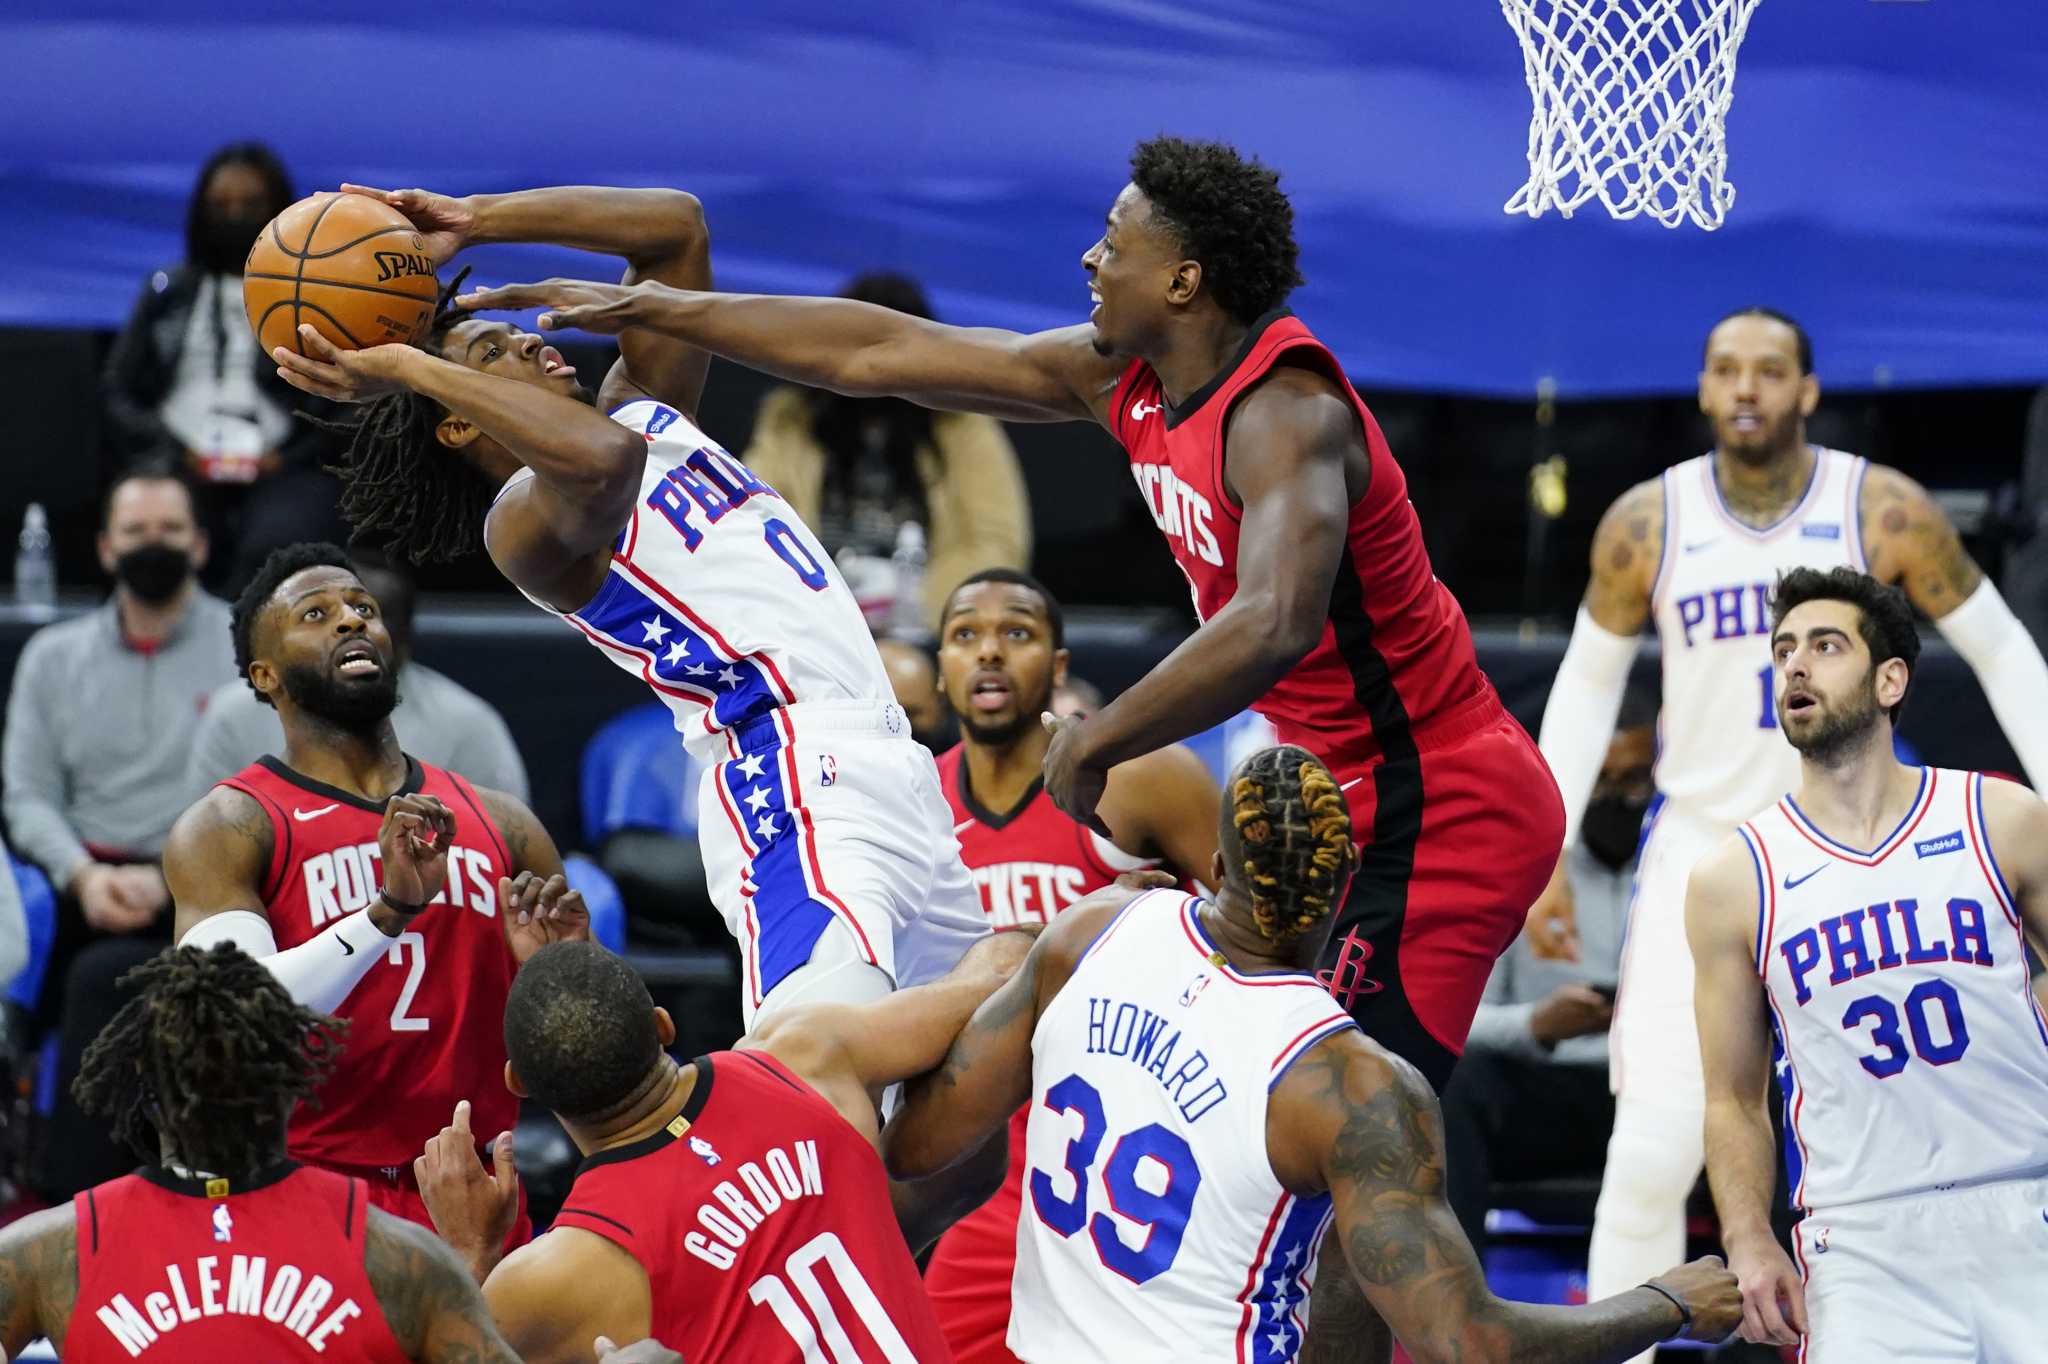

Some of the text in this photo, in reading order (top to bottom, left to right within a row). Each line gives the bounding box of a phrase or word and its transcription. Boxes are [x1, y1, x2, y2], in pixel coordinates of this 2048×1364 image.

[763, 518, 829, 591] 0
[388, 932, 429, 1031] 2
[1780, 897, 1994, 1007] PHILA
[1087, 998, 1228, 1123] HOWARD
[1842, 978, 1970, 1080] 30
[684, 1140, 824, 1270] GORDON
[1030, 1073, 1202, 1285] 39
[95, 1254, 362, 1358] McLEMORE
